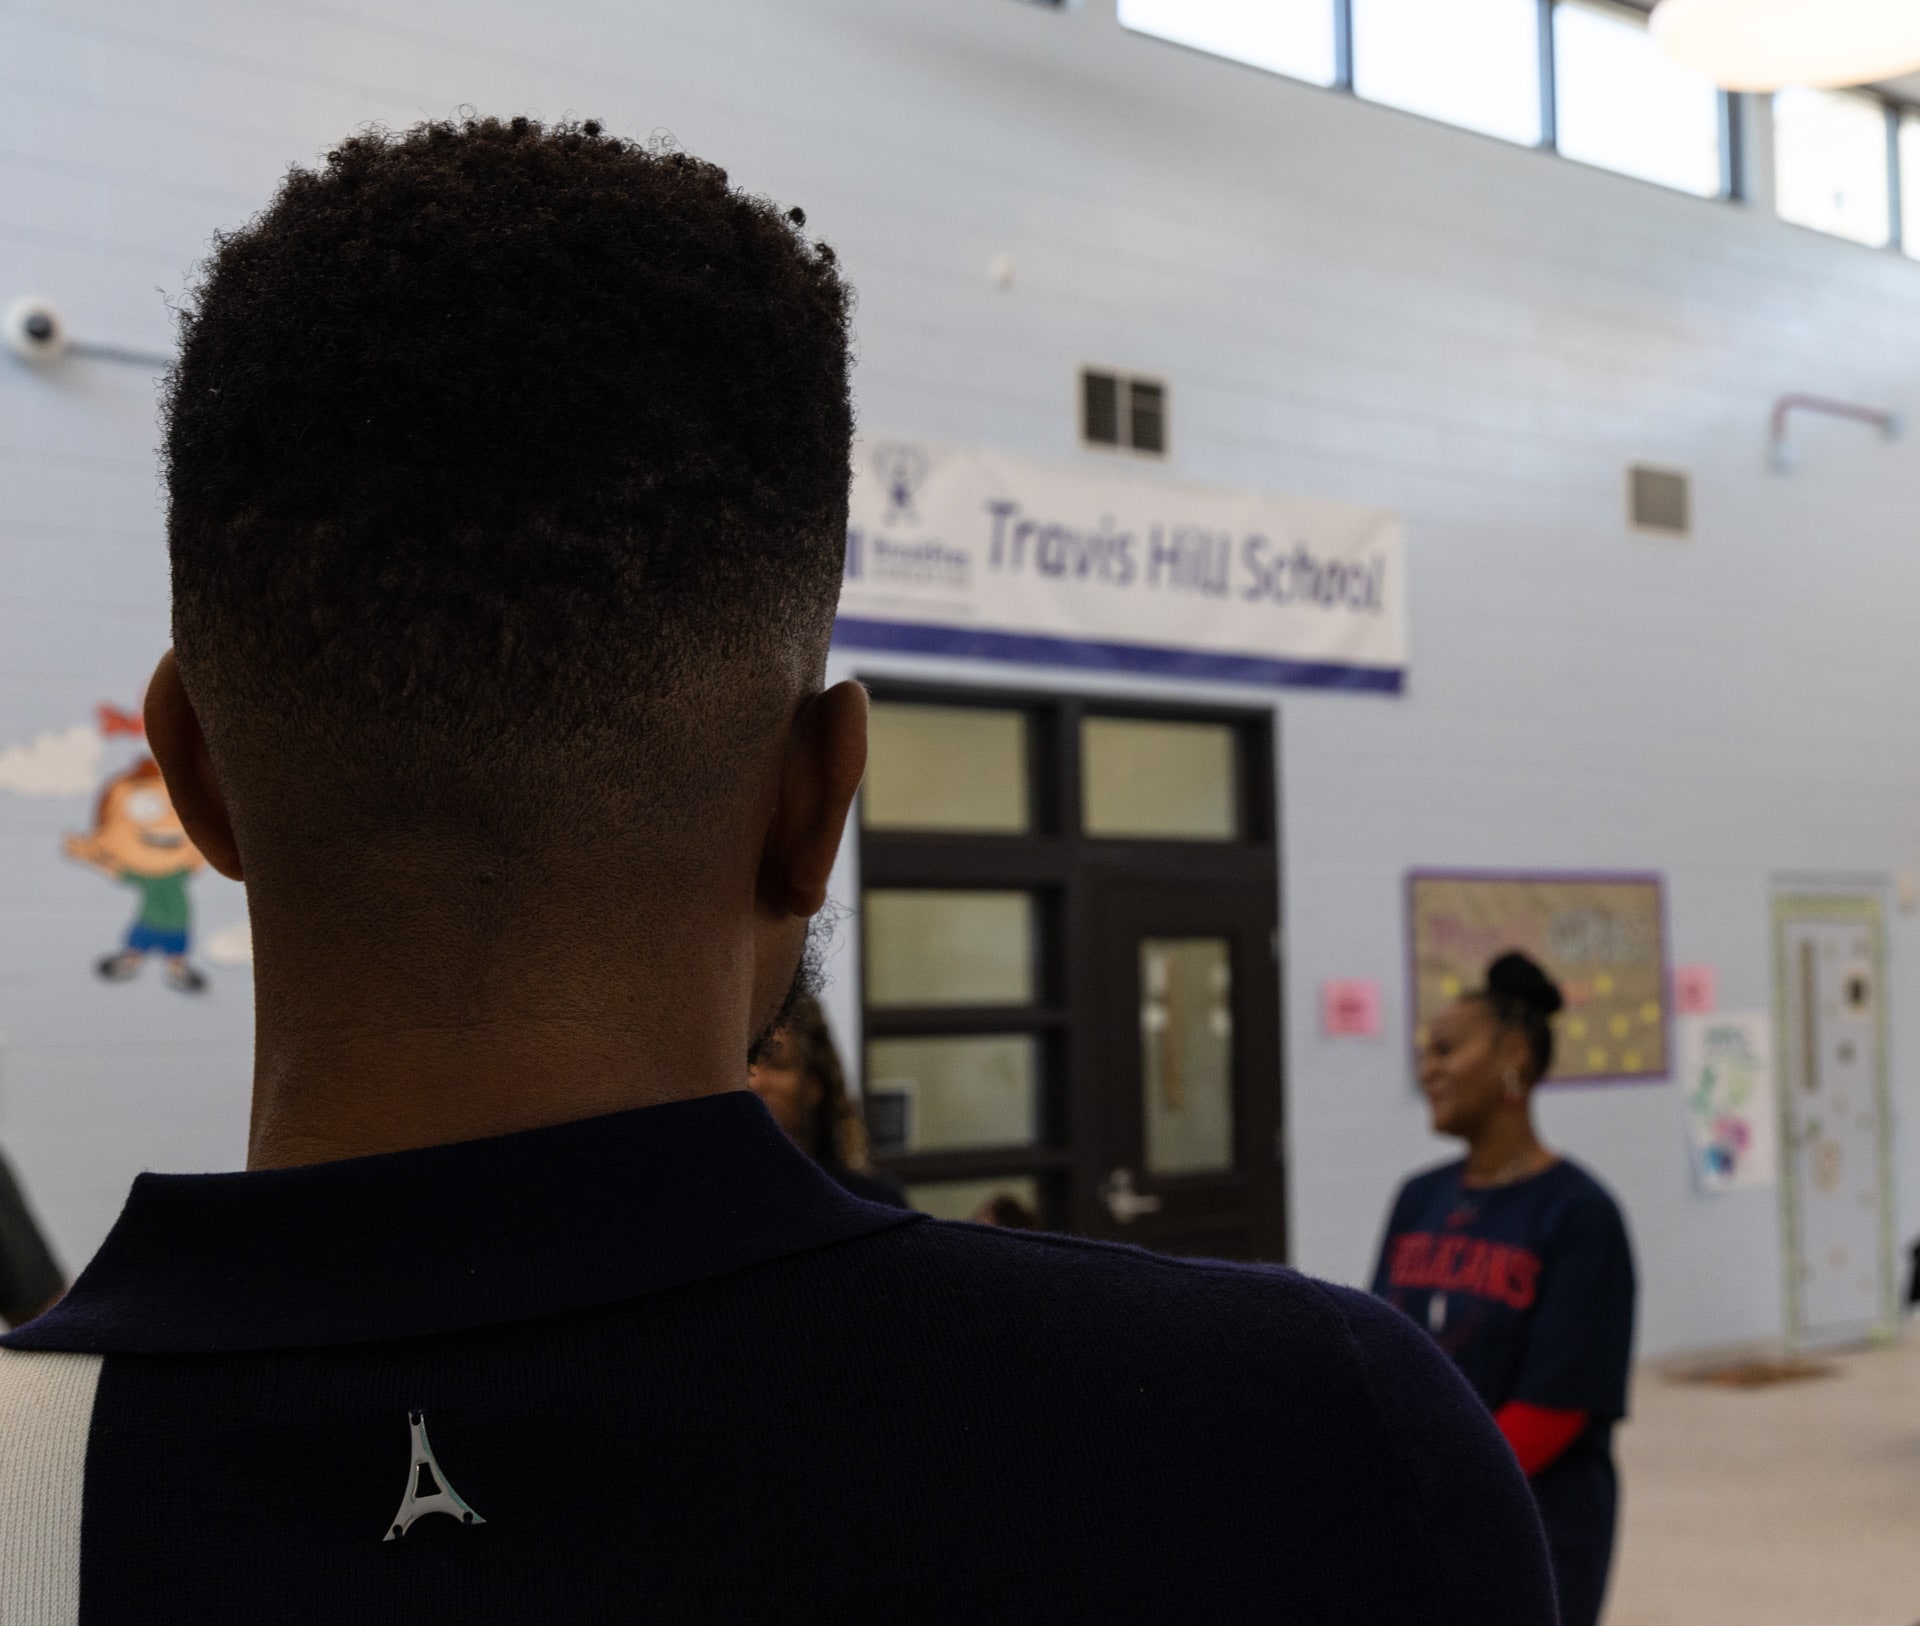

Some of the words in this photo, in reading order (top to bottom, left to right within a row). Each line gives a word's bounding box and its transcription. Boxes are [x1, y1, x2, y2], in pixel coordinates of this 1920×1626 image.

[985, 500, 1136, 588] Travis
[1146, 522, 1231, 598] Hill
[1242, 533, 1384, 616] School
